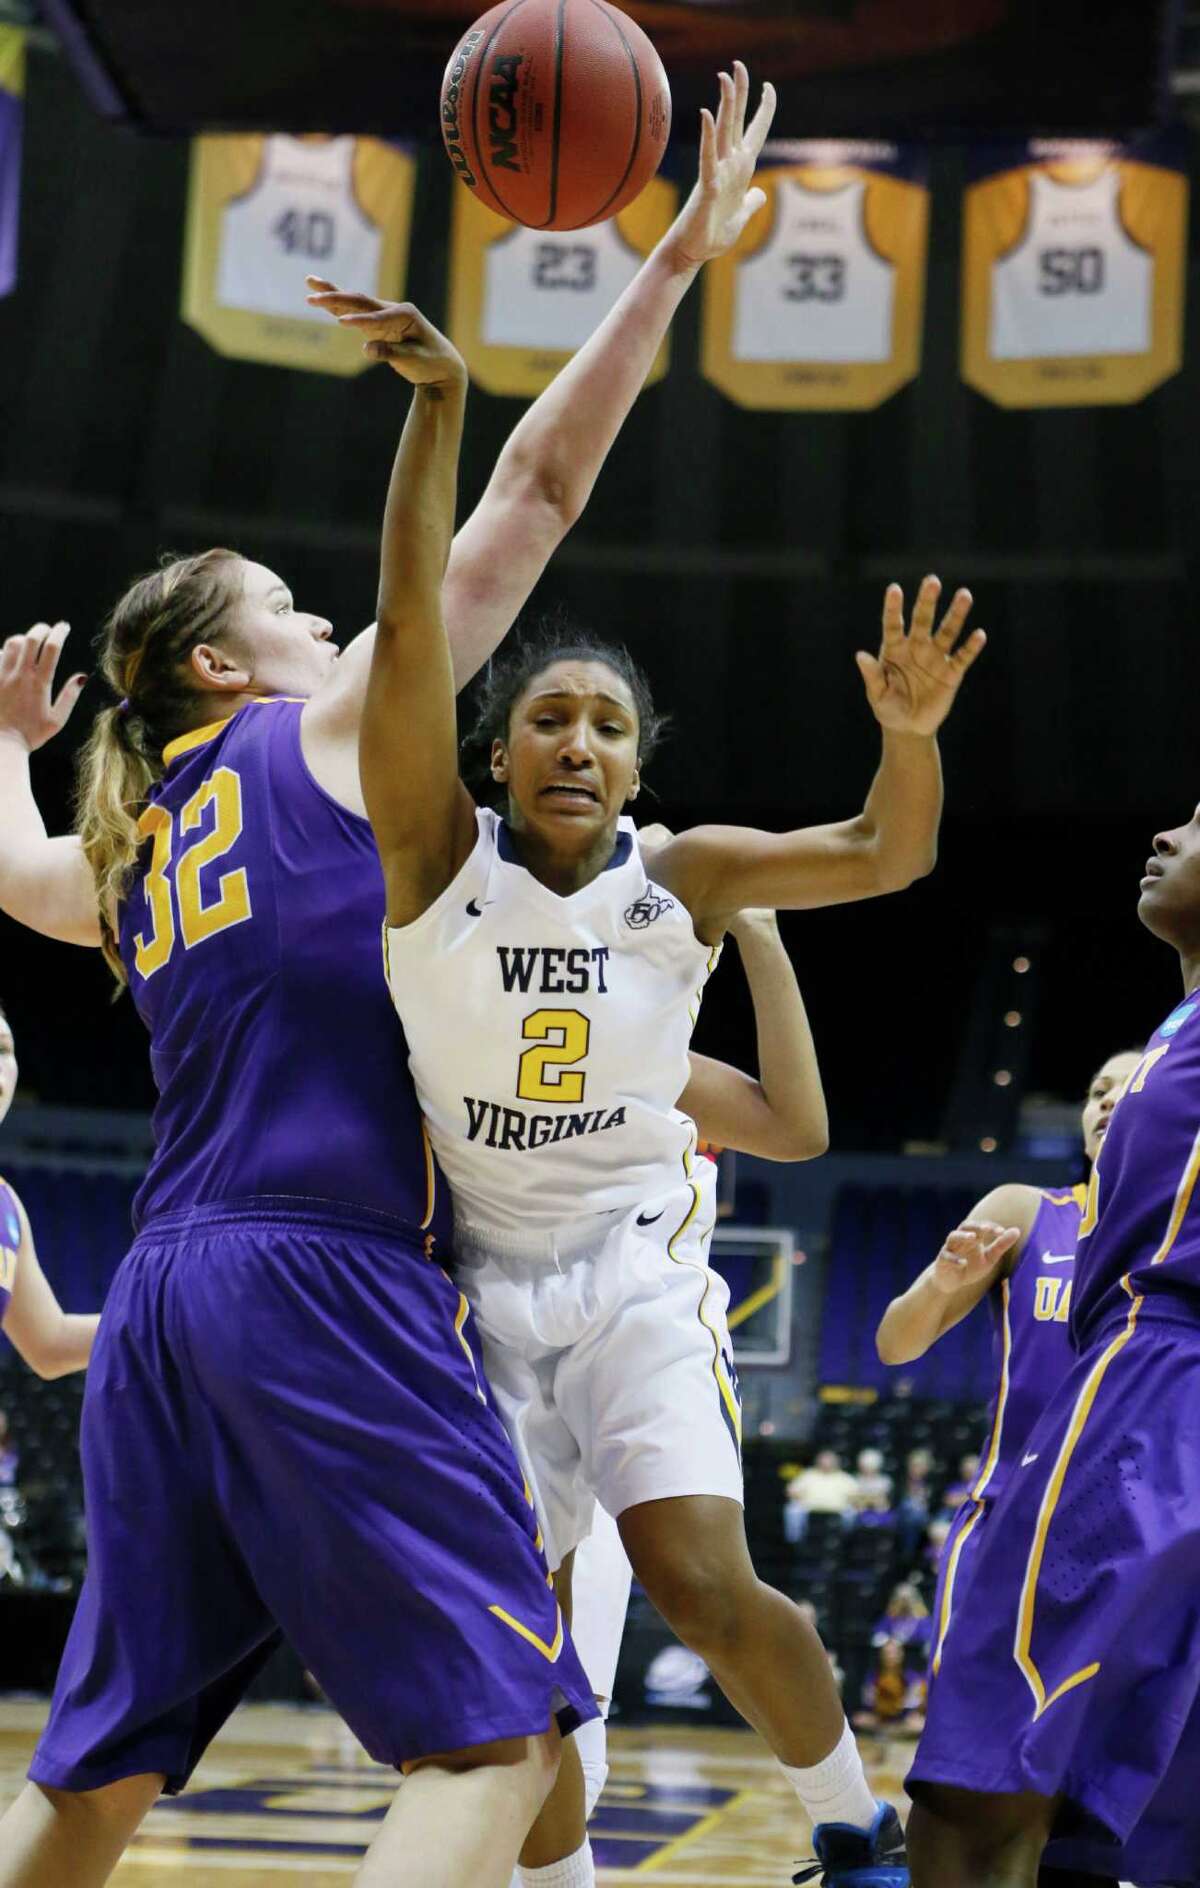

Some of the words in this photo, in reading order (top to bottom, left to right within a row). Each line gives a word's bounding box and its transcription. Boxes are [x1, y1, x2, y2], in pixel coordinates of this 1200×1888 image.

[489, 53, 523, 173] NCAA
[272, 208, 335, 261] 40
[531, 242, 597, 292] 23
[783, 255, 846, 304] 33
[1039, 246, 1105, 297] 50
[132, 766, 253, 981] 32
[496, 946, 609, 994] WEST
[516, 1008, 591, 1104] 2
[463, 1096, 627, 1152] VIRGINIA
